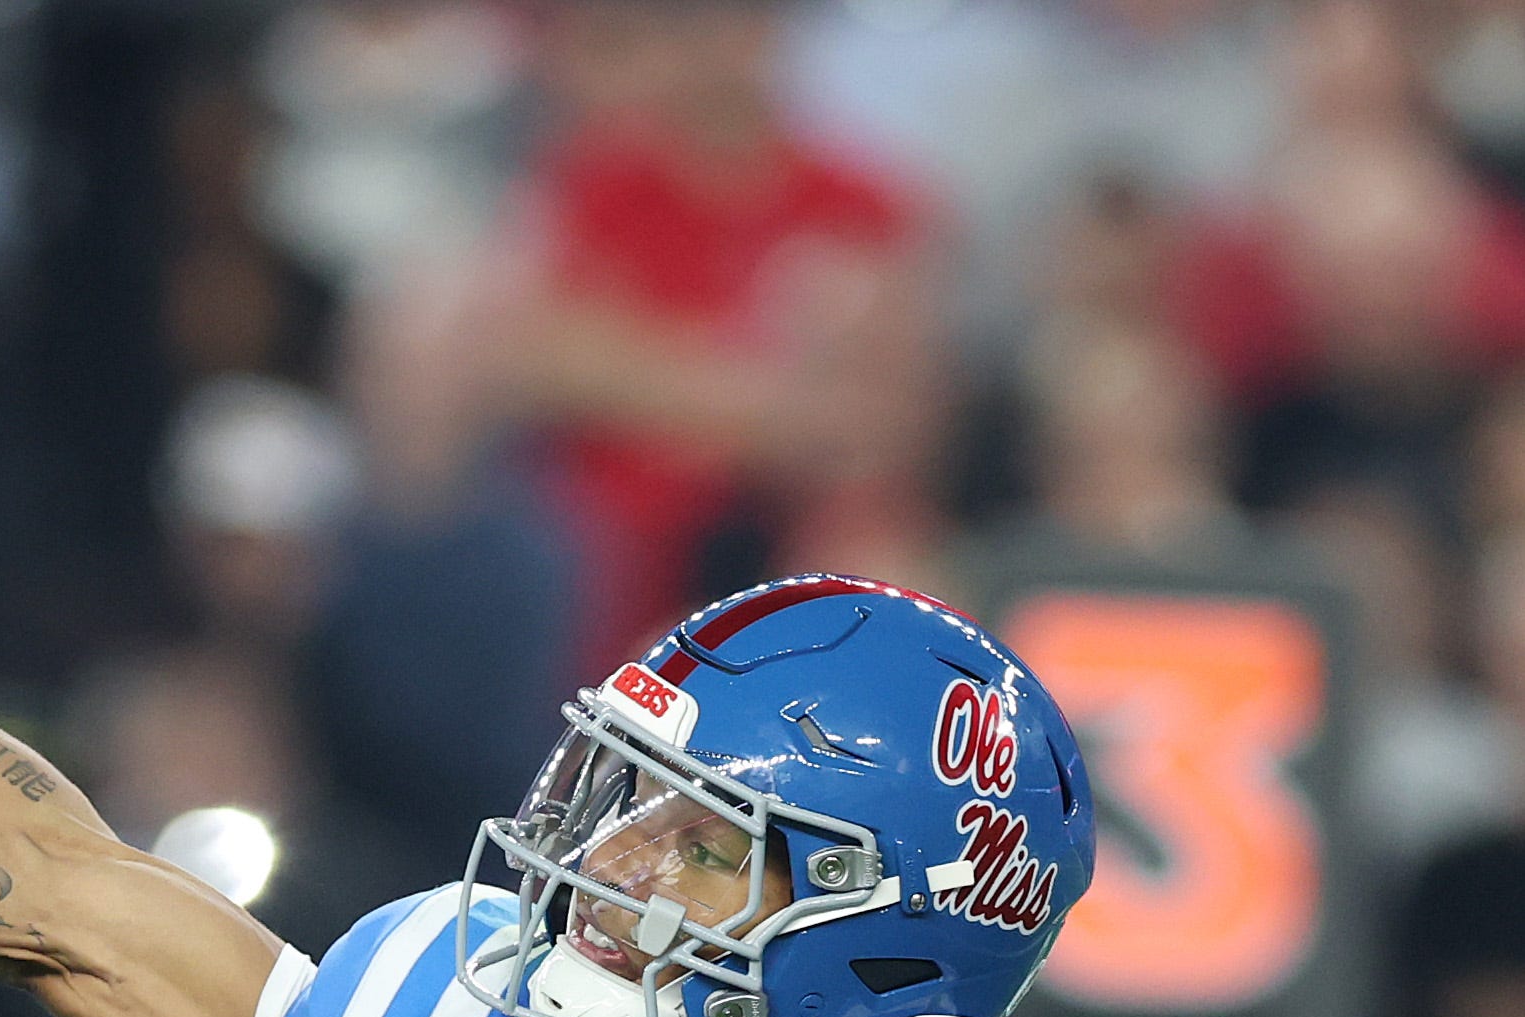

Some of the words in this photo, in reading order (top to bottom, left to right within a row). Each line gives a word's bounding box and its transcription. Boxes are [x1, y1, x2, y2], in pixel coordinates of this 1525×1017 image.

[932, 678, 1018, 798] Ole
[1000, 596, 1326, 1010] 3
[933, 799, 1059, 936] Miss
